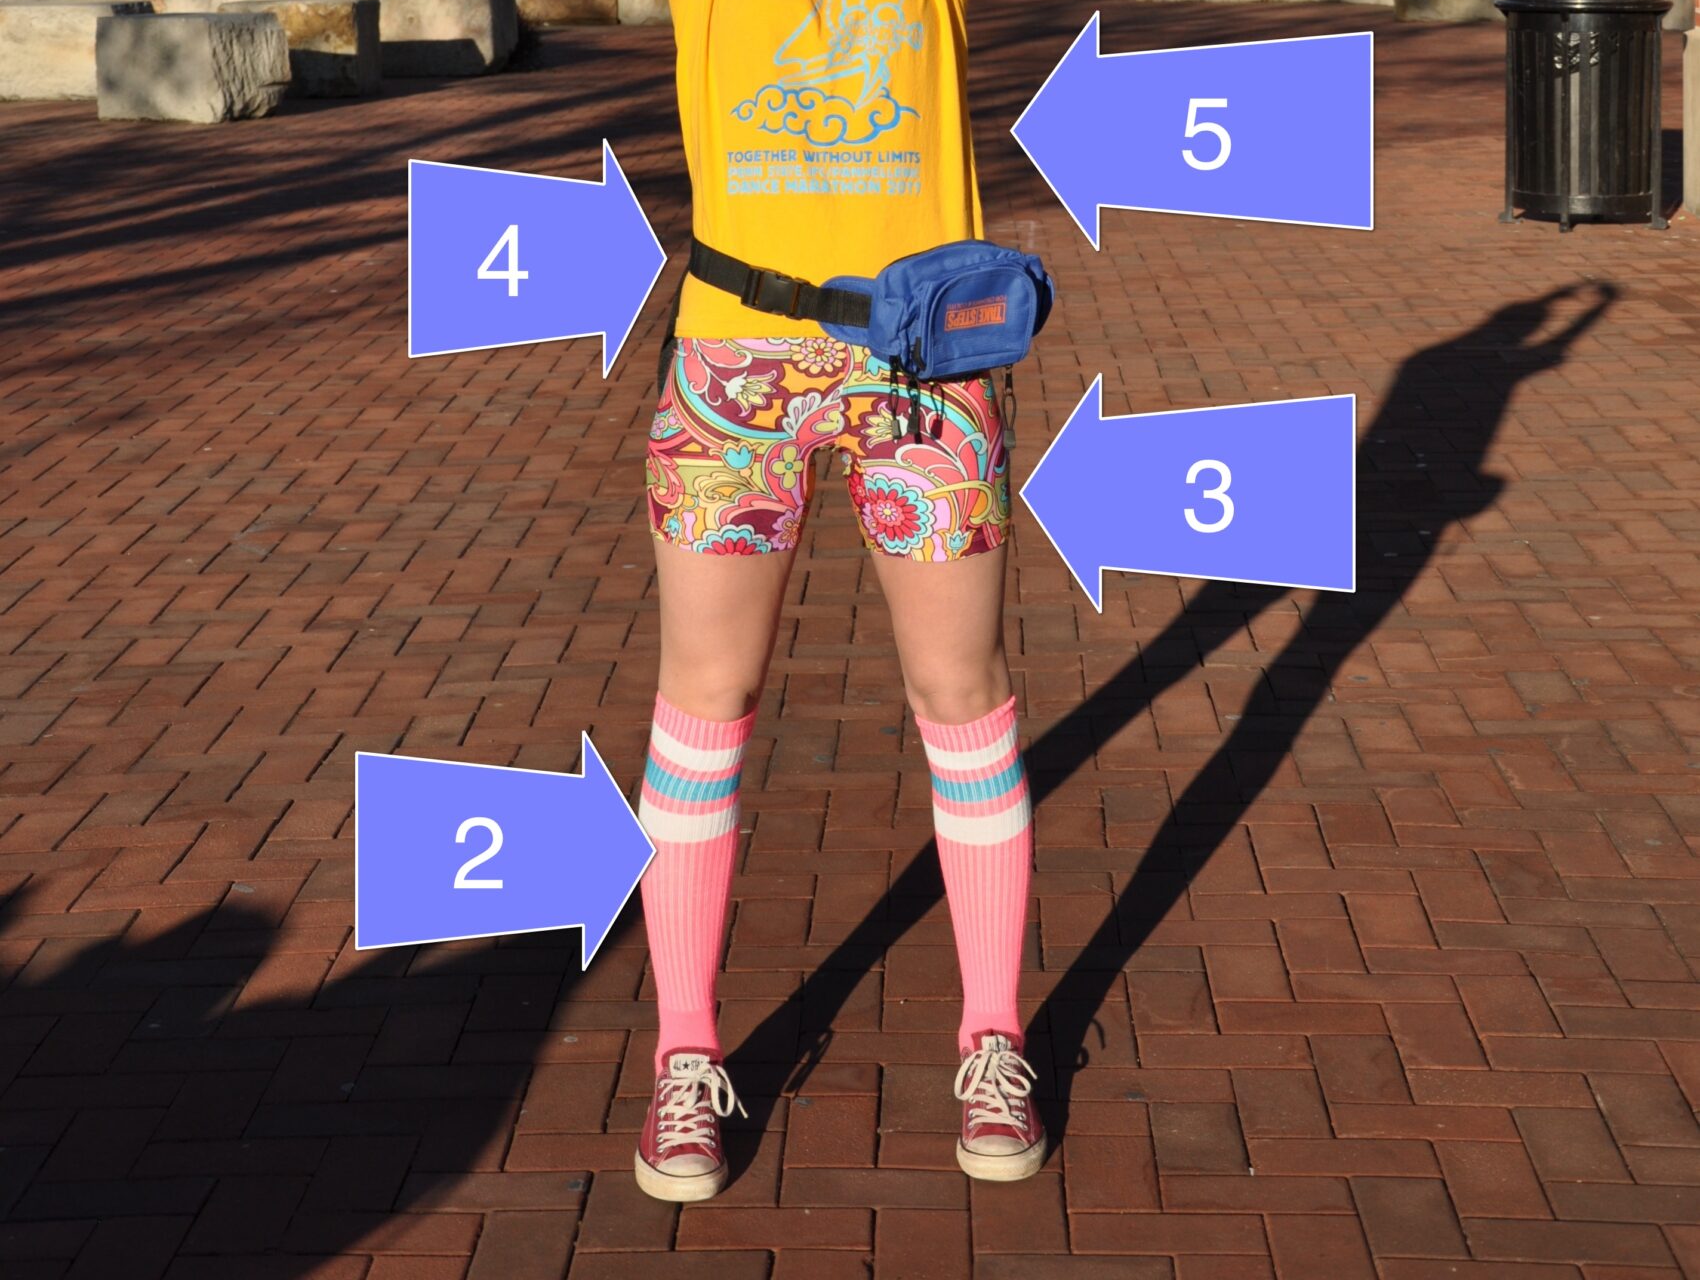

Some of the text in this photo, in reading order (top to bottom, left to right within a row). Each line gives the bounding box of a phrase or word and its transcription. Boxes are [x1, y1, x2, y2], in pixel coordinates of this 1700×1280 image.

[727, 150, 921, 164] TOGETHER WITHOUT LIMITS
[727, 166, 763, 178] PENN
[727, 180, 921, 195] DANCE MARATHON 2011
